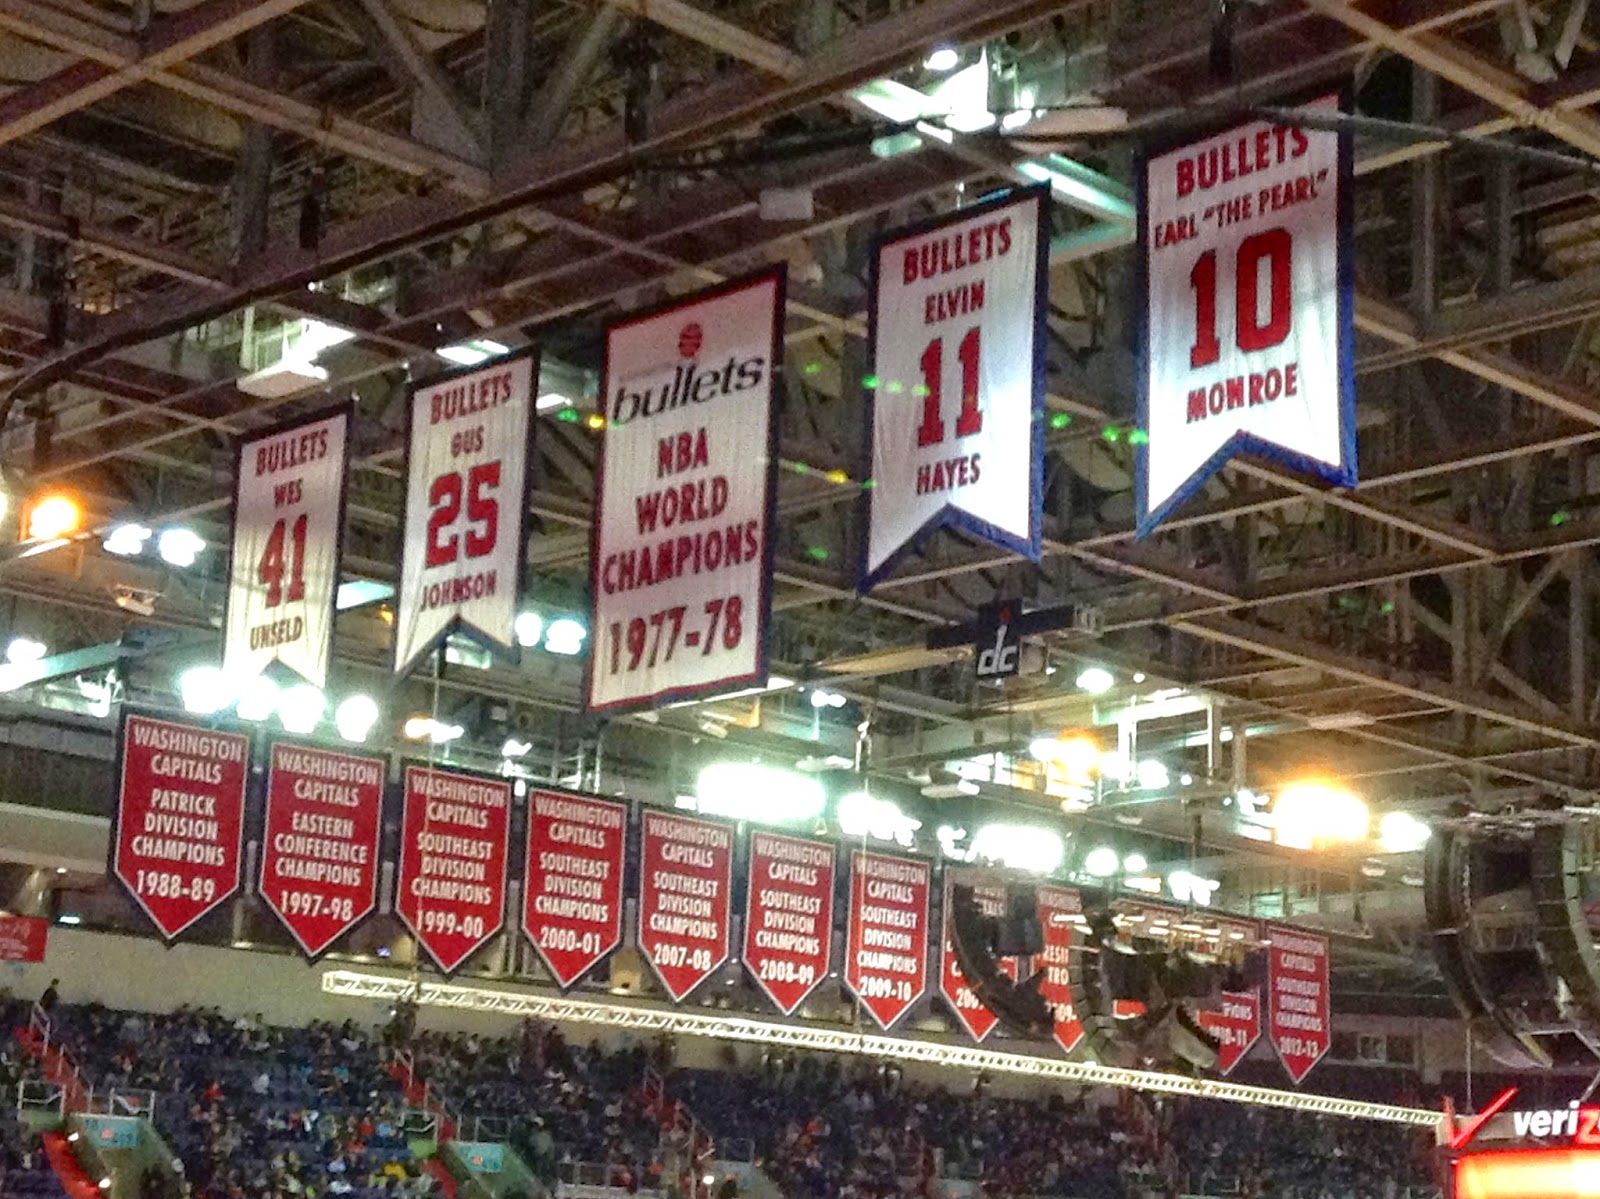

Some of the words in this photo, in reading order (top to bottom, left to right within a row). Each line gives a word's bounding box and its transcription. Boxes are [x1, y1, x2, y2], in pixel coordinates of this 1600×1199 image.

[1176, 127, 1308, 198] BULLETS
[1154, 213, 1198, 249] EARL
[903, 216, 1012, 285] BULLETS
[924, 279, 986, 324] ELVIN
[1190, 226, 1293, 370] 10
[430, 371, 513, 425] BULLETS
[612, 356, 765, 426] bullets
[917, 326, 984, 447] 11
[1187, 362, 1298, 424] MONROE
[255, 428, 329, 477] BULLETS
[657, 426, 709, 479] NBA
[916, 453, 981, 496] HAYES
[273, 478, 303, 508] WES
[635, 475, 729, 536] WORLD
[425, 460, 502, 570] 25
[258, 513, 308, 609] 41
[602, 520, 758, 595] CHAMPIONS
[419, 570, 498, 613] JOHNSON
[250, 616, 303, 651] UNSELD
[610, 595, 743, 675] 1977-78
[133, 724, 243, 762] WASHINGTON
[150, 755, 223, 785] CAPITALS
[278, 751, 378, 786] WASHINGTON
[151, 788, 217, 817] PATRICK
[294, 778, 360, 808] CAPITALS
[412, 774, 505, 807] WASHINGTON
[144, 812, 218, 842] DIVISION
[292, 811, 354, 839] EASTERN
[427, 802, 489, 829] CAPITALS
[535, 797, 621, 829] WASHINGTON
[417, 832, 494, 860] SOUTHEAST
[549, 822, 606, 849] CAPITALS
[649, 818, 729, 849] WASHINGTON
[131, 835, 226, 867] CHAMPIONS
[274, 833, 369, 865] CONFERENCE
[661, 843, 714, 868] CAPITALS
[756, 838, 832, 867] WASHINGTON
[275, 856, 362, 887] CHAMPIONS
[421, 856, 486, 882] DIVISION
[539, 852, 611, 880] SOUTHEAST
[768, 861, 818, 887] CAPITALS
[136, 869, 217, 903] 1988-89
[411, 878, 493, 906] CHAMPIONS
[544, 874, 603, 900] DIVISION
[653, 870, 718, 898] SOUTHEAST
[867, 880, 914, 904] CAPITALS
[279, 890, 354, 922] 1997-98
[535, 896, 609, 923] CHAMPIONS
[657, 893, 712, 918] DIVISION
[760, 889, 821, 915] SOUTHEAST
[416, 909, 484, 939] 1999-00
[650, 913, 718, 941] CHAMPIONS
[764, 910, 816, 934] DIVISION
[860, 905, 918, 930] SOUTHEAST
[540, 926, 602, 956] 2000-01
[756, 930, 820, 957] CHAMPIONS
[864, 928, 913, 951] DIVISION
[654, 942, 713, 972] 2007-08
[857, 951, 918, 975] CHAMPIONS
[859, 976, 913, 1001] 2009-10
[1513, 1100, 1600, 1145] veriz
